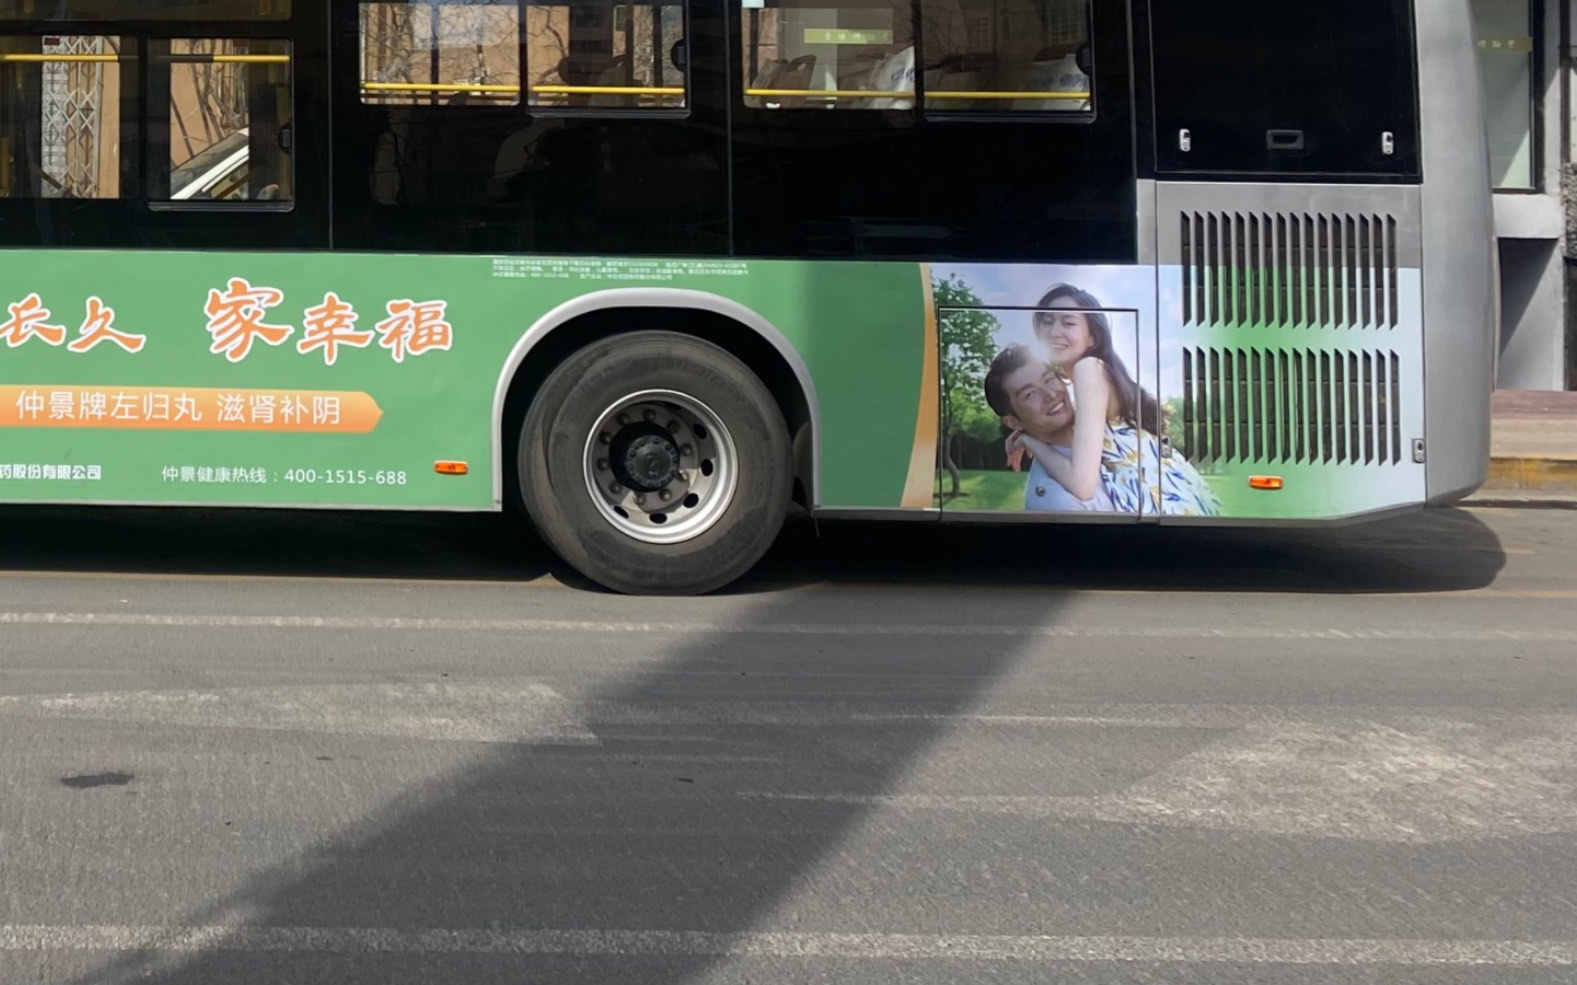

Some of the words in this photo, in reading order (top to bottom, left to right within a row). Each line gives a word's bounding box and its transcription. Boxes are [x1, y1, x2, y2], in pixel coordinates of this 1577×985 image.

[204, 277, 454, 366] 家幸福
[15, 389, 203, 423] 仲景牌左归丸
[216, 393, 342, 426] 滋肾补阴
